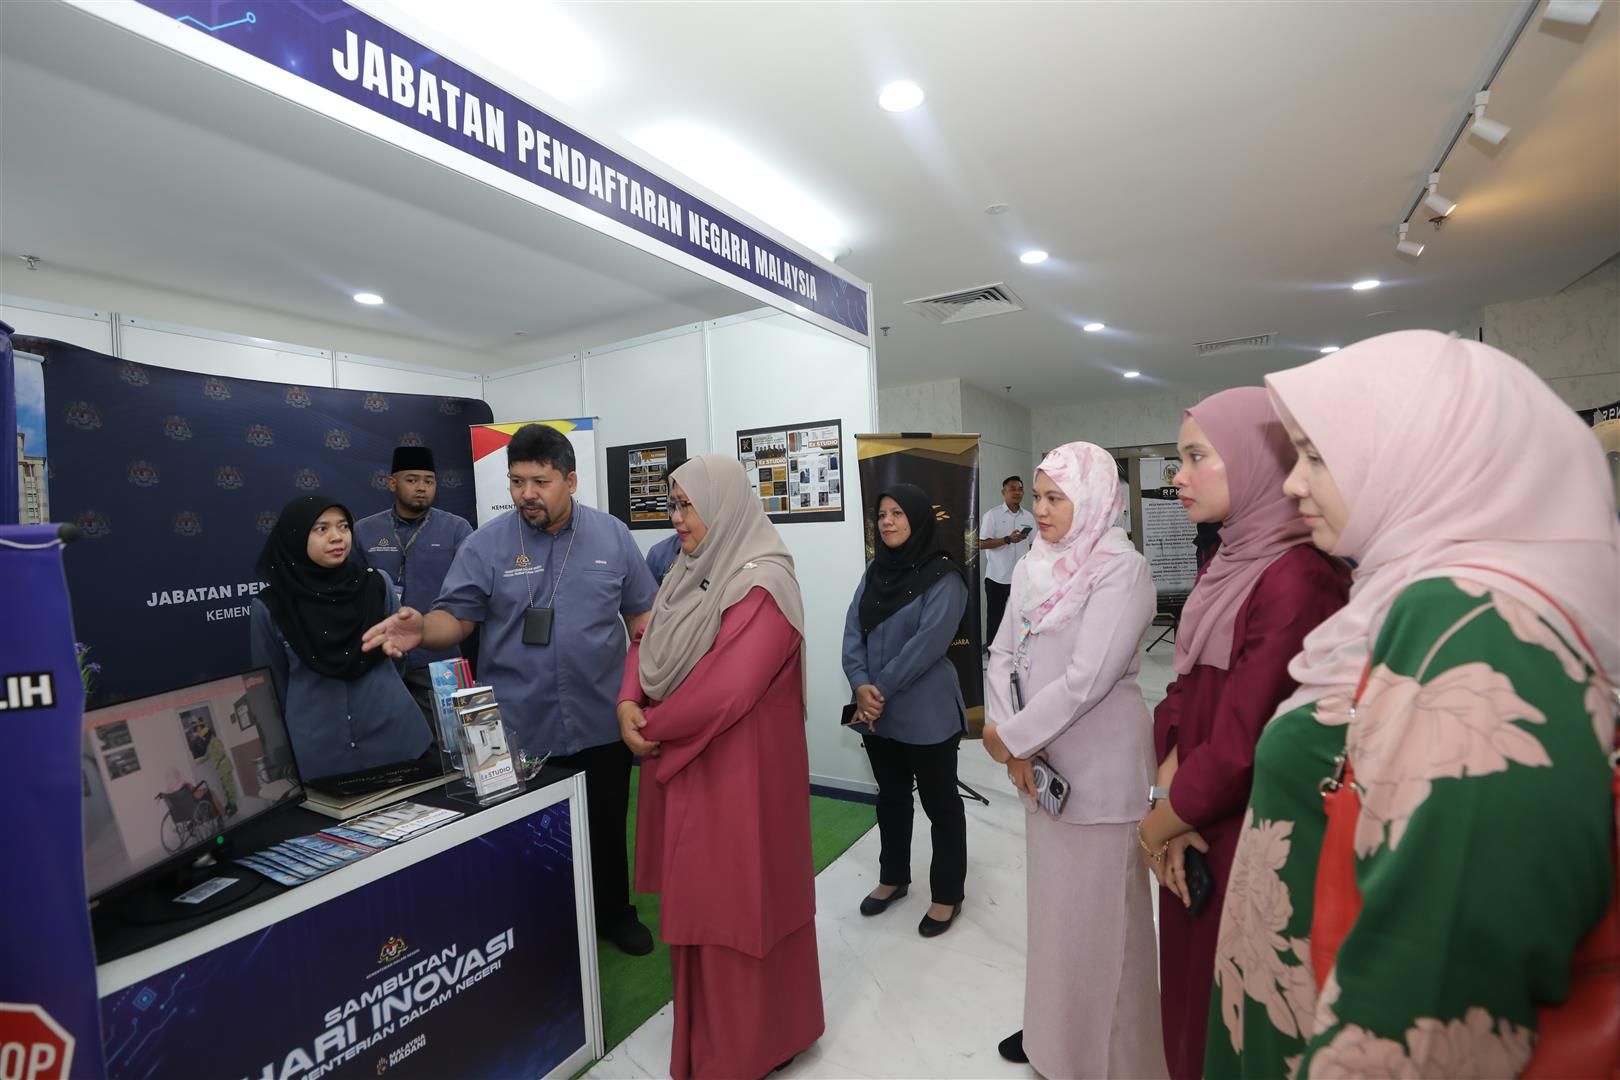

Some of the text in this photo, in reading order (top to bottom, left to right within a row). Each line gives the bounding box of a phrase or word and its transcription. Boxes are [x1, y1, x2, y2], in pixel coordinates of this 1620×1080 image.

[332, 29, 817, 301] JABATAN PENDAFTARAN NEGARA MALAYSIA
[816, 439, 838, 447] STUDIO
[146, 584, 232, 607] JABATAN
[206, 605, 252, 621] KEMEN
[489, 766, 511, 777] STUDIO
[324, 943, 457, 1028] SAMBUTAN
[371, 927, 515, 1030] INOVASI
[400, 990, 452, 1028] DALAM
[456, 959, 501, 994] NEGERI
[389, 1033, 425, 1060] MALAYSIA
[390, 1040, 426, 1067] MADANI
